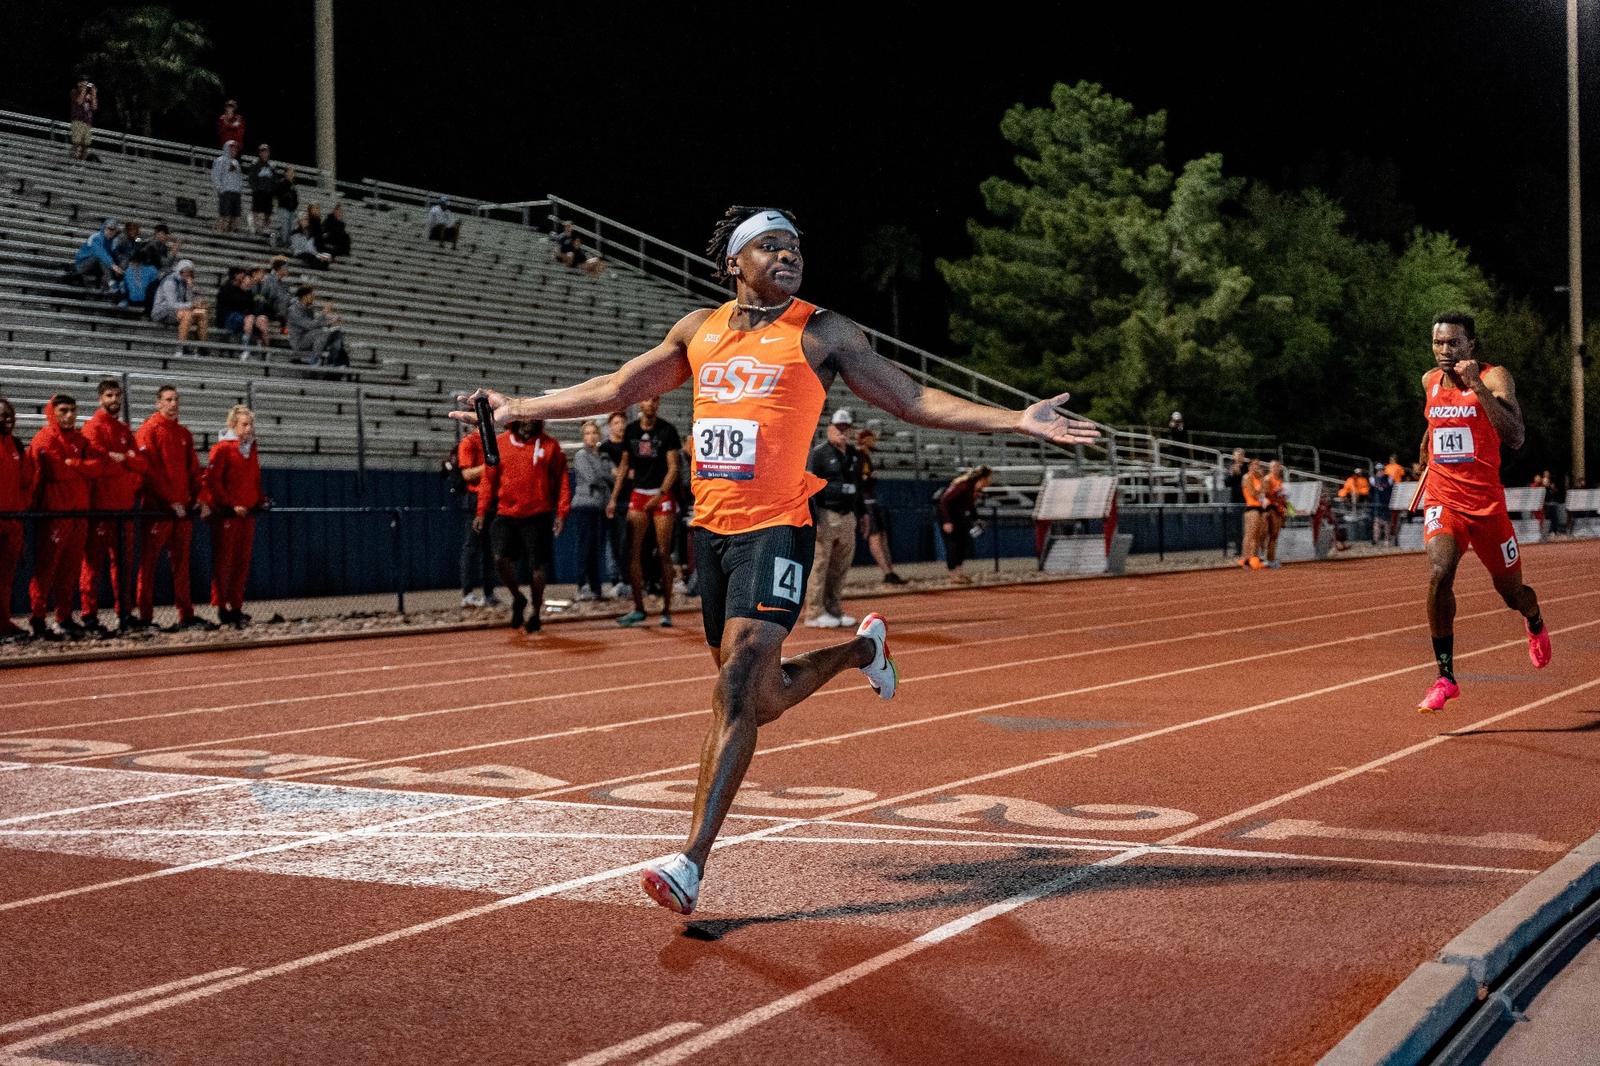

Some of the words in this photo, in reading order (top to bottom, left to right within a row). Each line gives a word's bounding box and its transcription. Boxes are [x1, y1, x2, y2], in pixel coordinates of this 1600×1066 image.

[699, 356, 784, 404] OSU
[1428, 405, 1478, 418] ARIZONA
[700, 428, 744, 458] 318
[1438, 433, 1463, 451] 141
[1506, 540, 1516, 560] 6
[778, 563, 797, 599] 4
[896, 793, 1199, 831] 2
